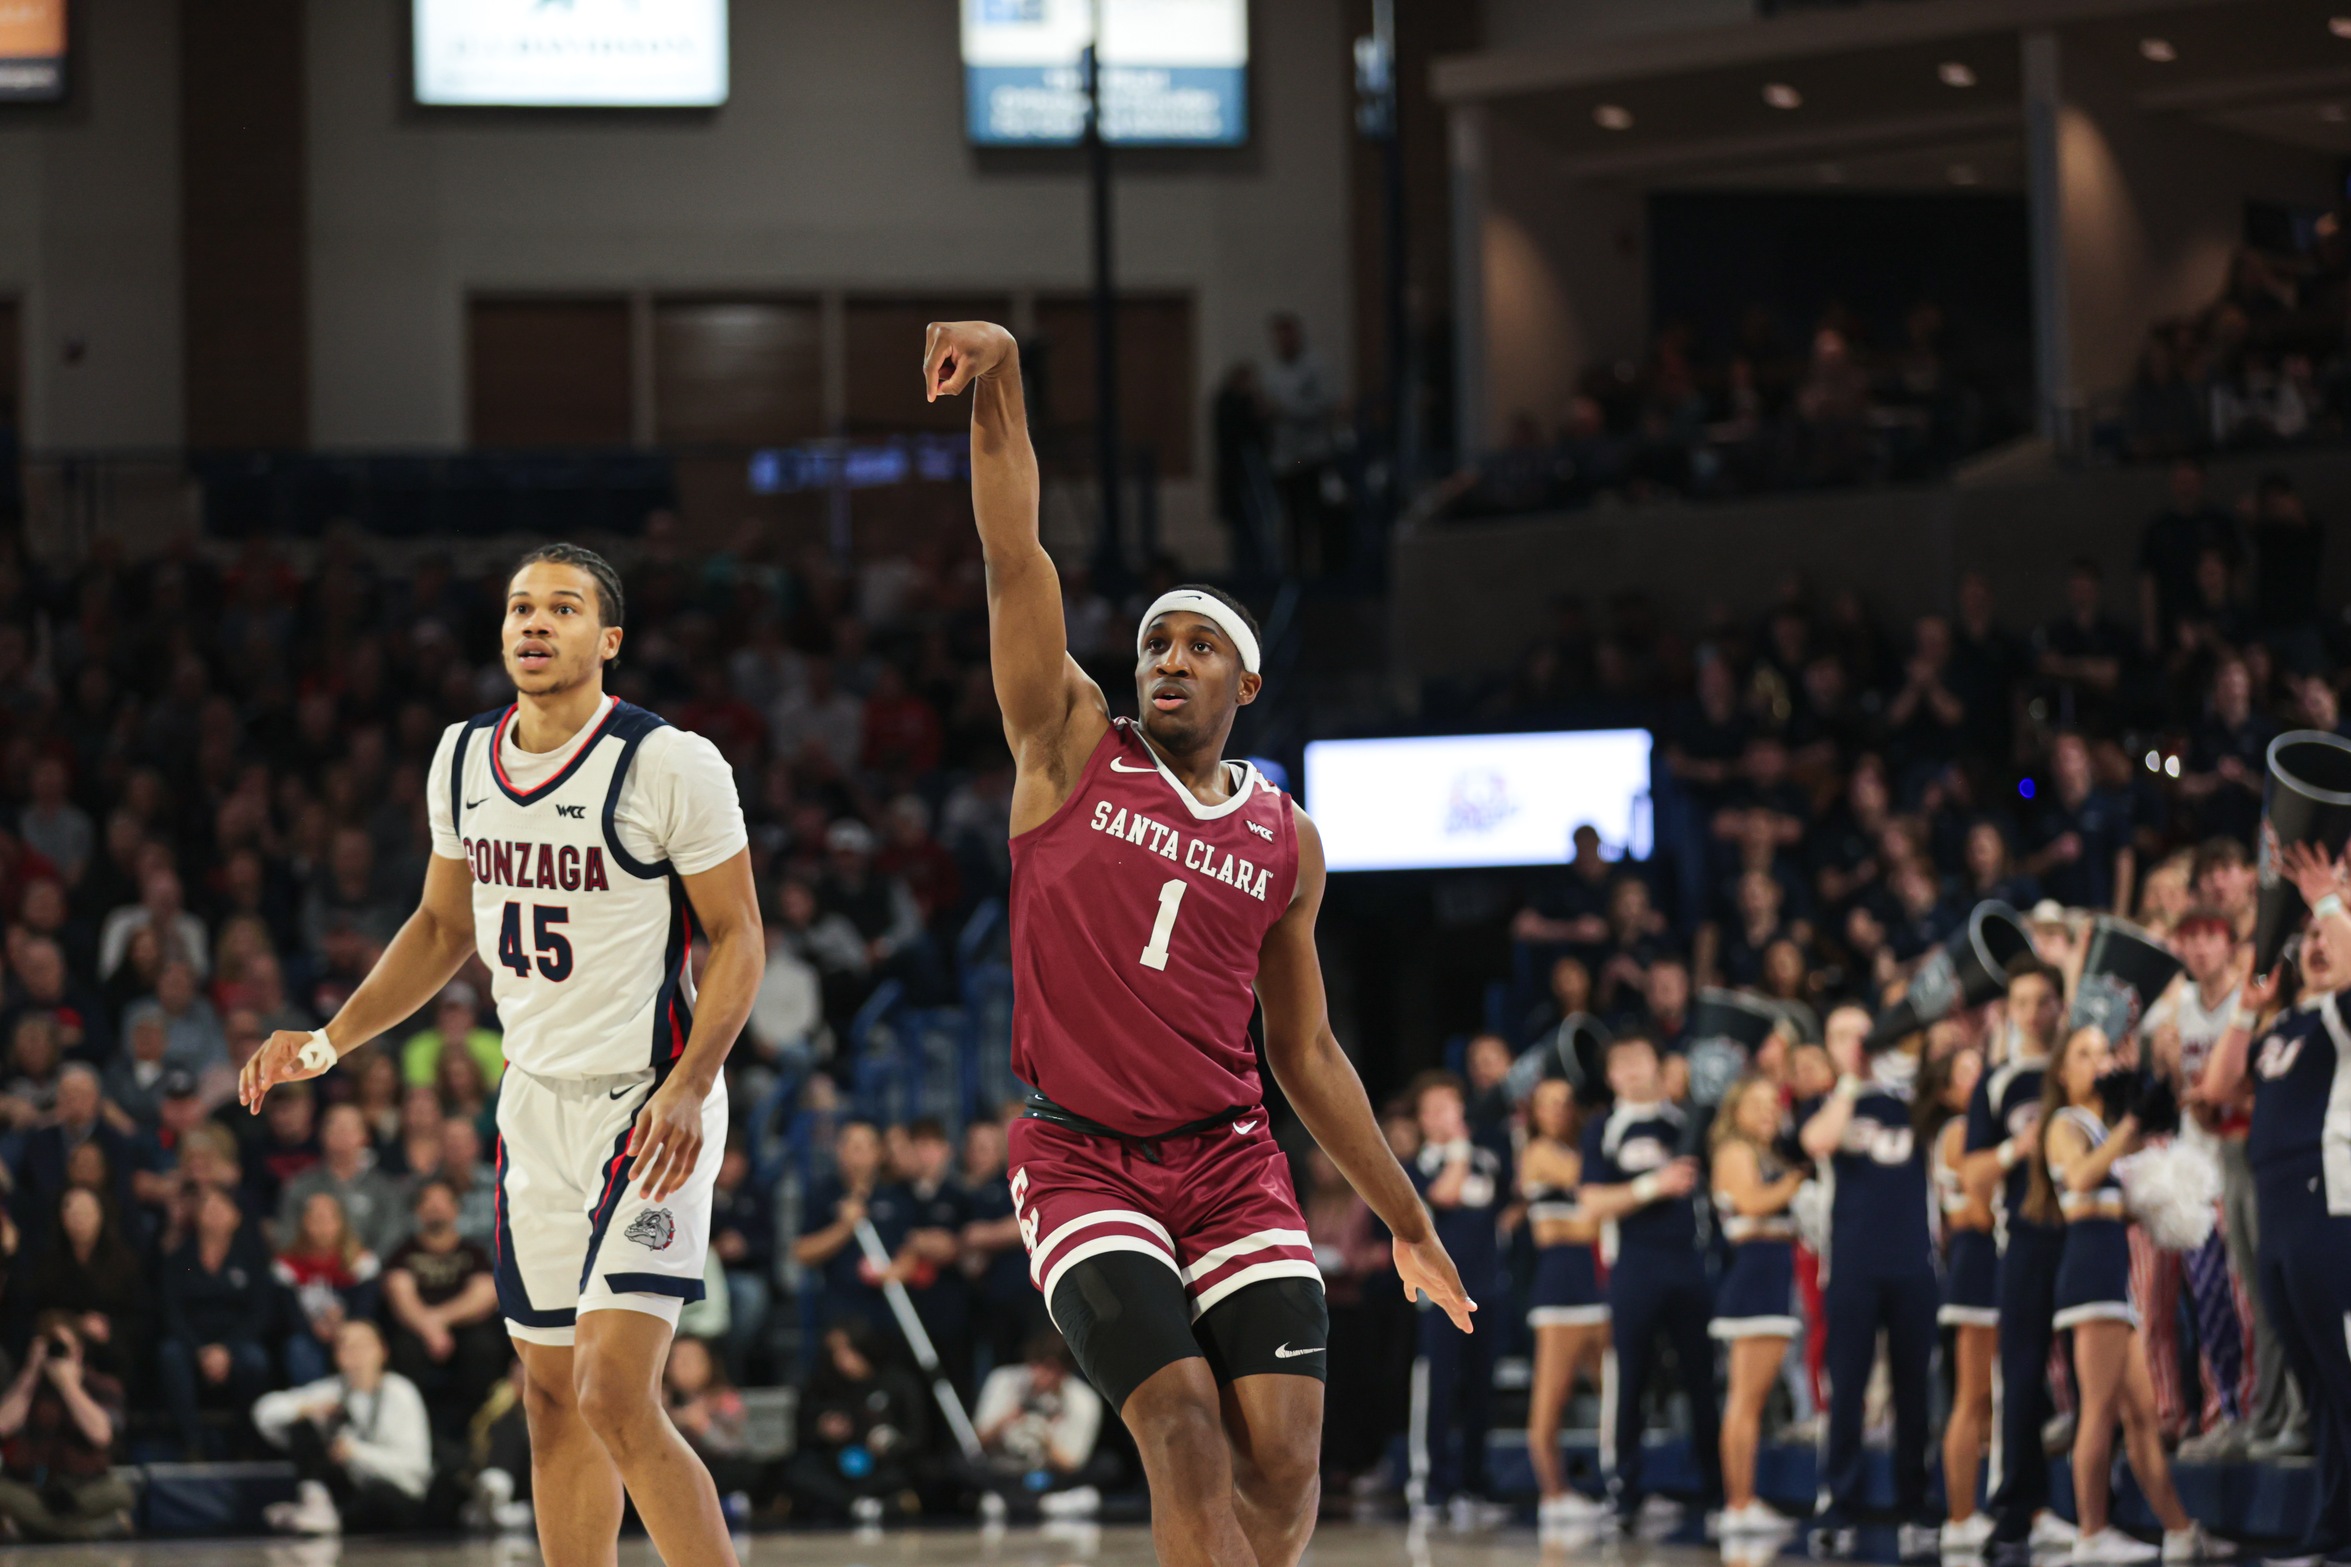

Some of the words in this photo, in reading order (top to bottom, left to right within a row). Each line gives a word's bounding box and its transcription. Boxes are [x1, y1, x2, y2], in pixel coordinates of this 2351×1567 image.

[555, 804, 587, 819] WCC
[1245, 819, 1274, 842] WCC
[463, 837, 609, 892] GONZAGA
[1091, 800, 1179, 861] SANTA
[1185, 839, 1266, 901] CLARA
[498, 901, 574, 983] 45
[1139, 878, 1188, 972] 1
